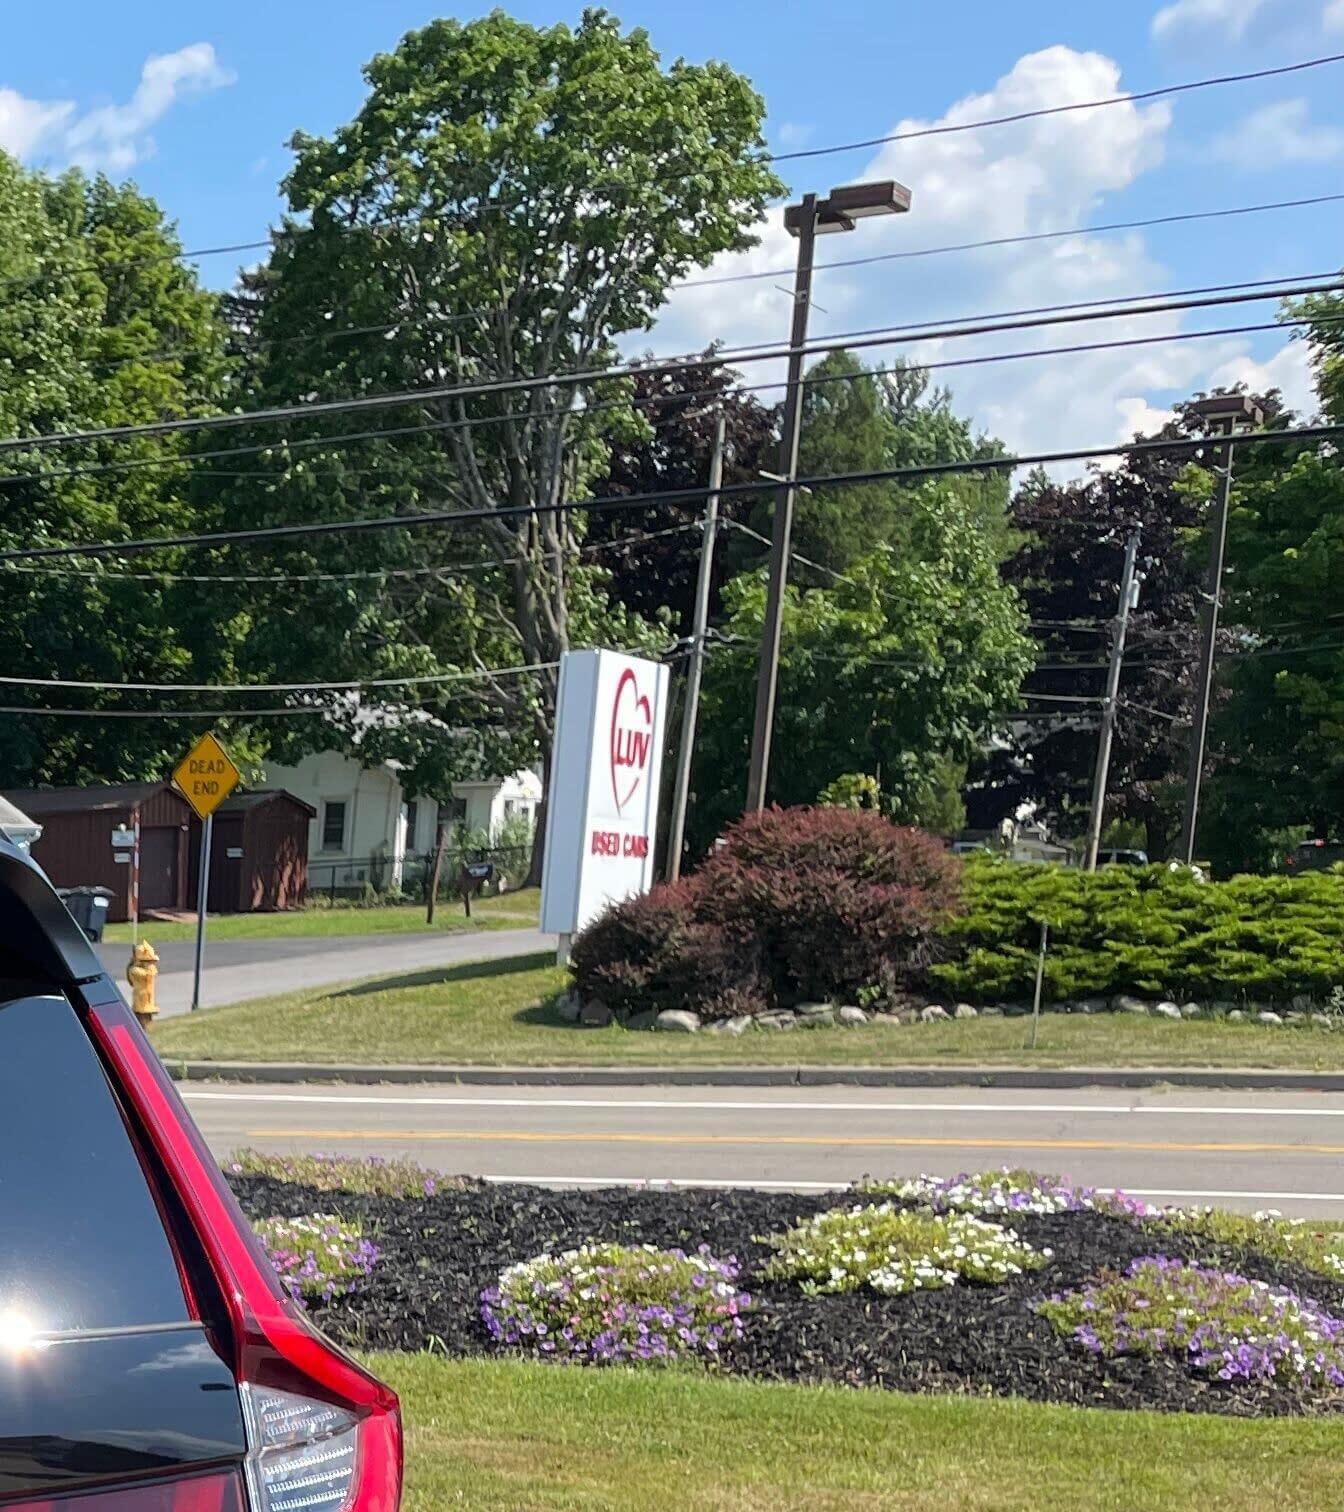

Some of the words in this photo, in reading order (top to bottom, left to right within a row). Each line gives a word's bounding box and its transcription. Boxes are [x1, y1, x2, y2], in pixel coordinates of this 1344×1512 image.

[614, 727, 651, 770] LUV
[189, 760, 225, 774] DEAD
[193, 780, 219, 795] END
[591, 830, 620, 856] USED
[623, 832, 649, 858] CARS
